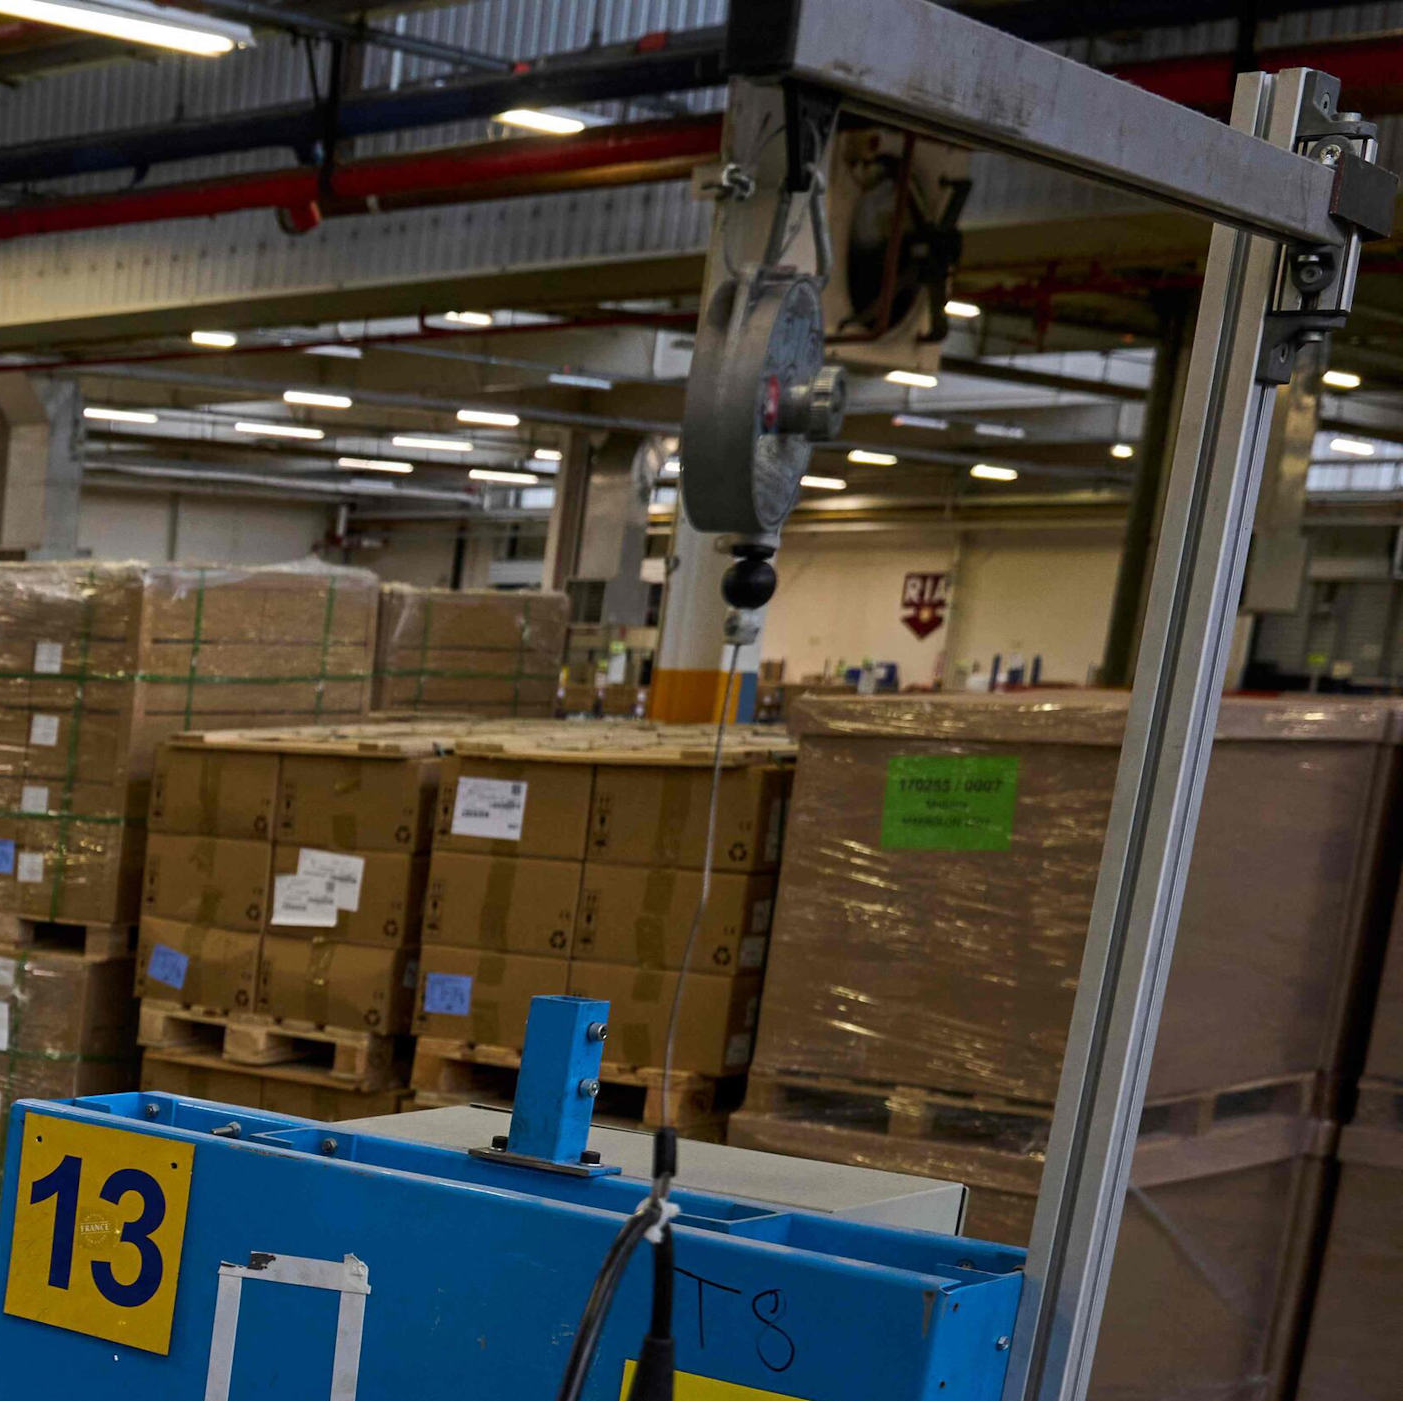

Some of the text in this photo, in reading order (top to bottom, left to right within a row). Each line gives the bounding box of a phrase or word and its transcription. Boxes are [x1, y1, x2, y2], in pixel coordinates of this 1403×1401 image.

[905, 578, 947, 603] RIA
[30, 1155, 166, 1308] 13
[80, 1223, 110, 1233] FRANCE
